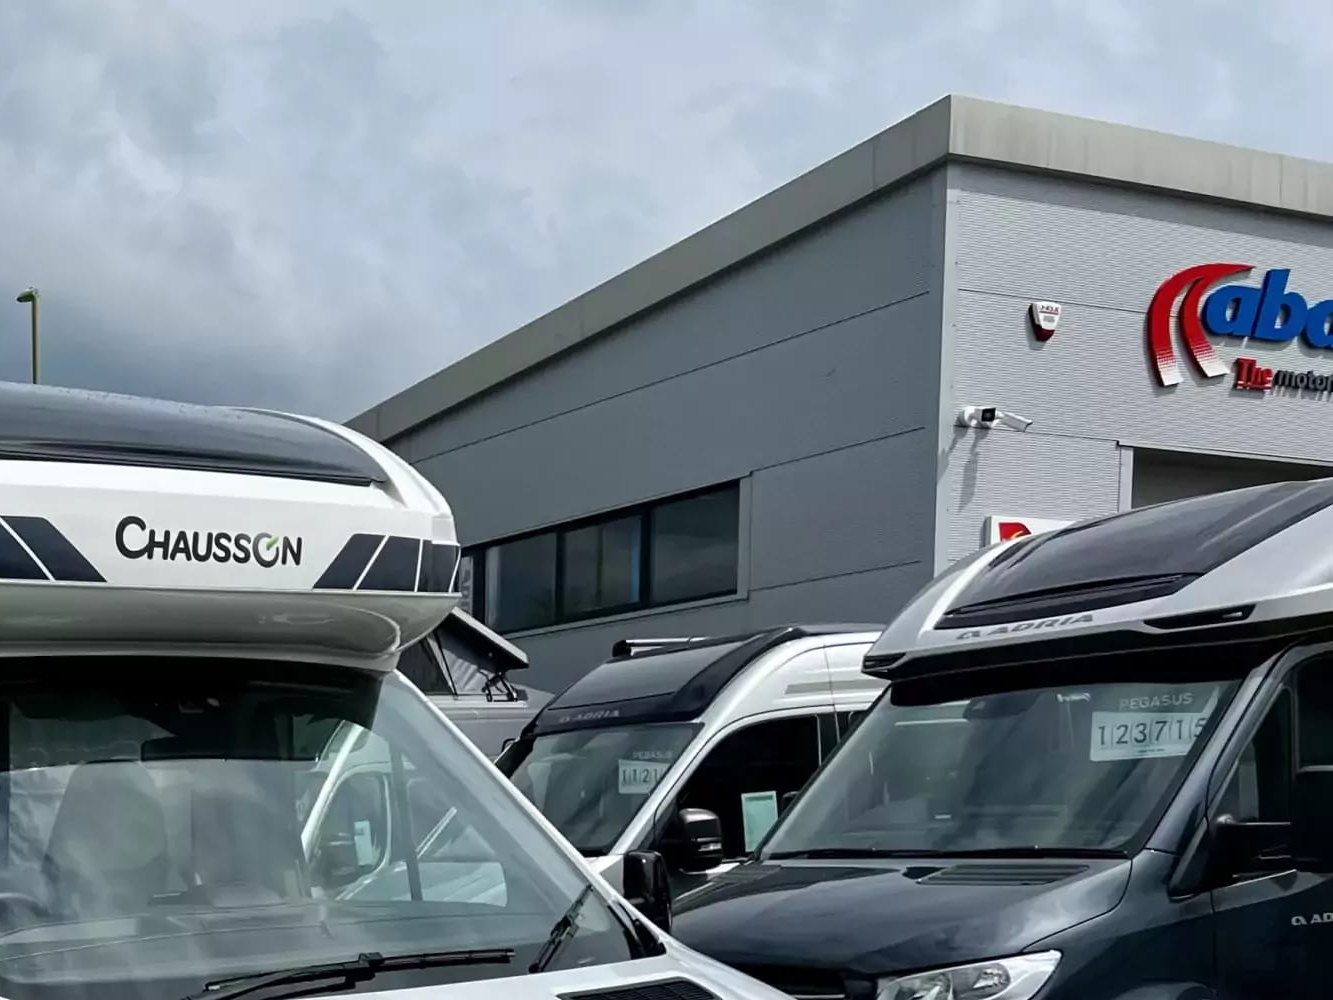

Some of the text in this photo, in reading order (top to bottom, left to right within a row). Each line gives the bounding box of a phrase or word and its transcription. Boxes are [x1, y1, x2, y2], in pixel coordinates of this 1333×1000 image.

[1232, 356, 1274, 390] The
[115, 515, 303, 568] CHAUSSON
[987, 614, 1093, 636] ADRIA
[1119, 692, 1194, 710] PEGASUS
[573, 710, 619, 721] ADRIA
